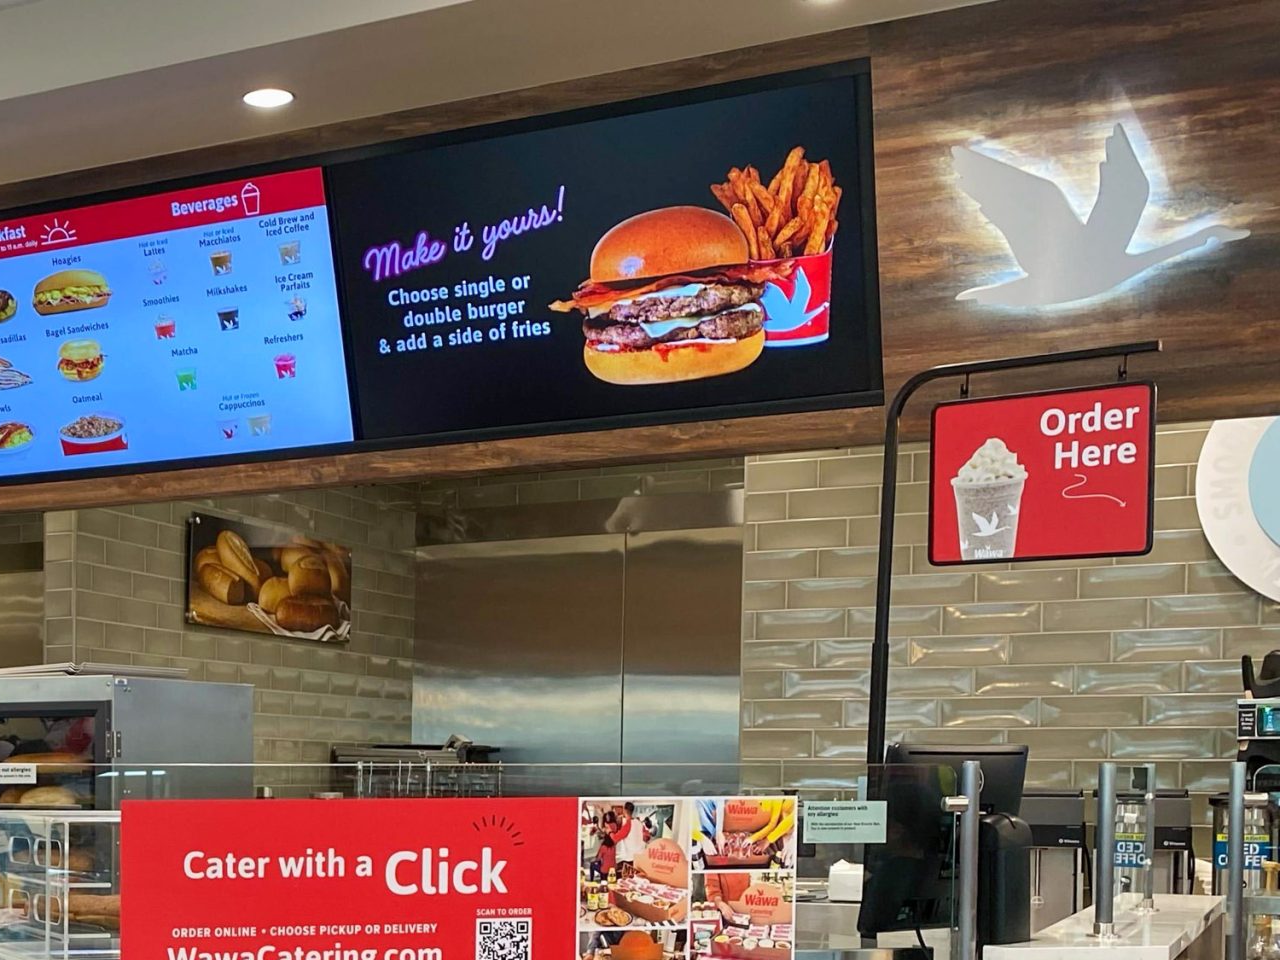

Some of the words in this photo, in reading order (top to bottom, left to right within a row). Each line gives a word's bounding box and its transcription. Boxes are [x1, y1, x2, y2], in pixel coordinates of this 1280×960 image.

[171, 192, 238, 217] Beverages
[259, 218, 277, 229] Cold
[279, 215, 297, 227] Brew
[298, 212, 315, 223] and
[266, 226, 283, 236] Iced
[284, 222, 309, 234] Coffee
[365, 231, 445, 282] Make
[455, 219, 473, 253] it
[483, 185, 566, 261] yours!
[199, 234, 241, 248] Macchiatos
[52, 254, 81, 267] Hoagies
[275, 273, 285, 284] Ice
[288, 270, 313, 282] Cream
[206, 284, 248, 298] Milkshakes
[280, 279, 311, 292] Parfaits
[388, 285, 448, 306] Choose
[454, 276, 506, 299] single
[511, 274, 531, 290] or
[142, 294, 180, 307] Smoothies
[404, 306, 461, 328] double
[467, 299, 525, 320] burger
[45, 326, 65, 338] Bagel
[67, 321, 109, 335] Sandwiches
[264, 332, 303, 346] Refreshers
[379, 338, 392, 354] &
[396, 332, 427, 353] add
[433, 334, 443, 348] a
[448, 327, 483, 347] side
[489, 323, 508, 342] of
[512, 320, 551, 340] fries
[171, 346, 198, 357] Matcha
[72, 393, 103, 404] Oatmeal
[218, 398, 265, 411] Cappuccinos
[1040, 402, 1139, 436] Order
[1054, 442, 1137, 469] Here
[183, 850, 270, 880] Cater
[279, 849, 345, 878] with
[355, 856, 372, 877] a
[385, 847, 508, 895] Click
[172, 927, 211, 937] ORDER
[214, 926, 257, 937] ONLINE
[270, 925, 316, 936] CHOOSE
[319, 924, 361, 935] PICKUP
[365, 924, 380, 934] OR
[384, 923, 437, 934] DELIVERY
